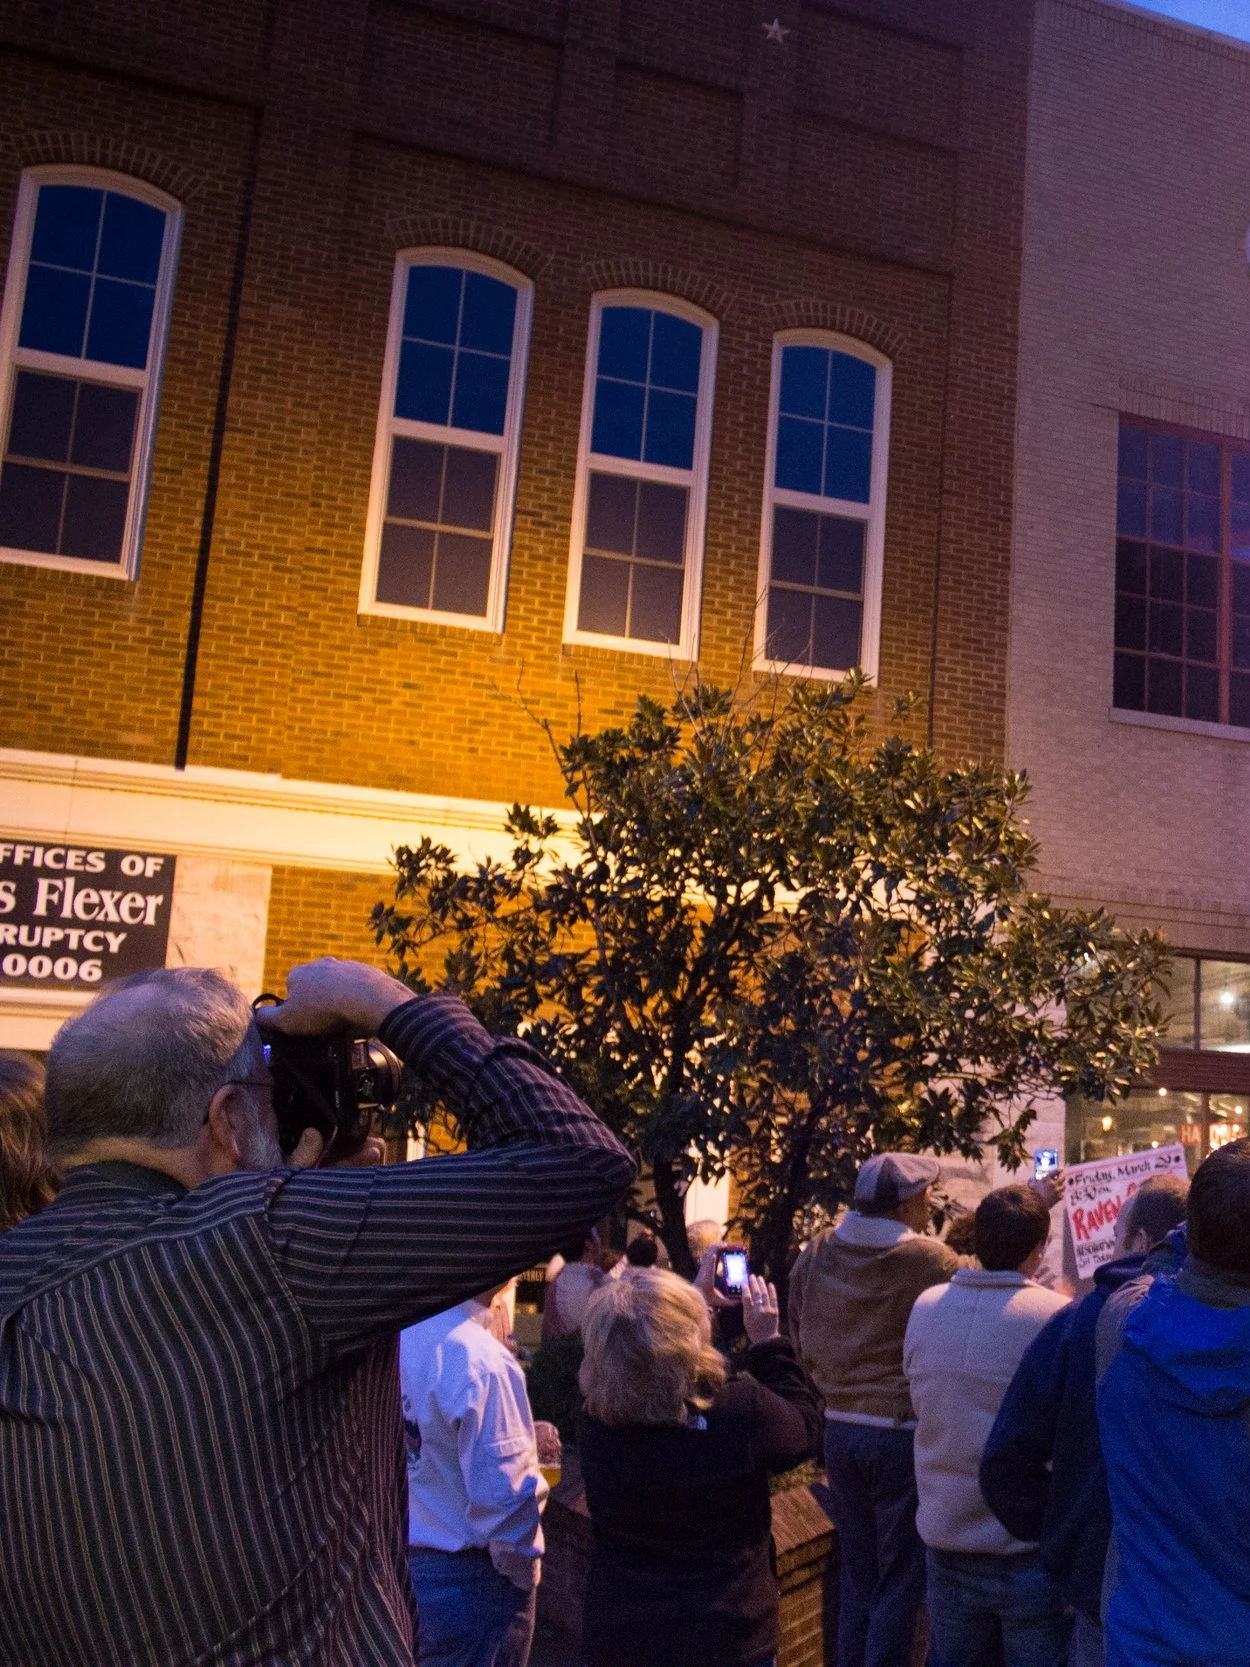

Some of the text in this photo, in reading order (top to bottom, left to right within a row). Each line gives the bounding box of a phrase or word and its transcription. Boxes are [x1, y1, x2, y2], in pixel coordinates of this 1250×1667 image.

[120, 854, 164, 878] OF
[33, 876, 163, 925] Flexer
[0, 922, 127, 954] RUPTCY
[2, 953, 103, 982] 0006
